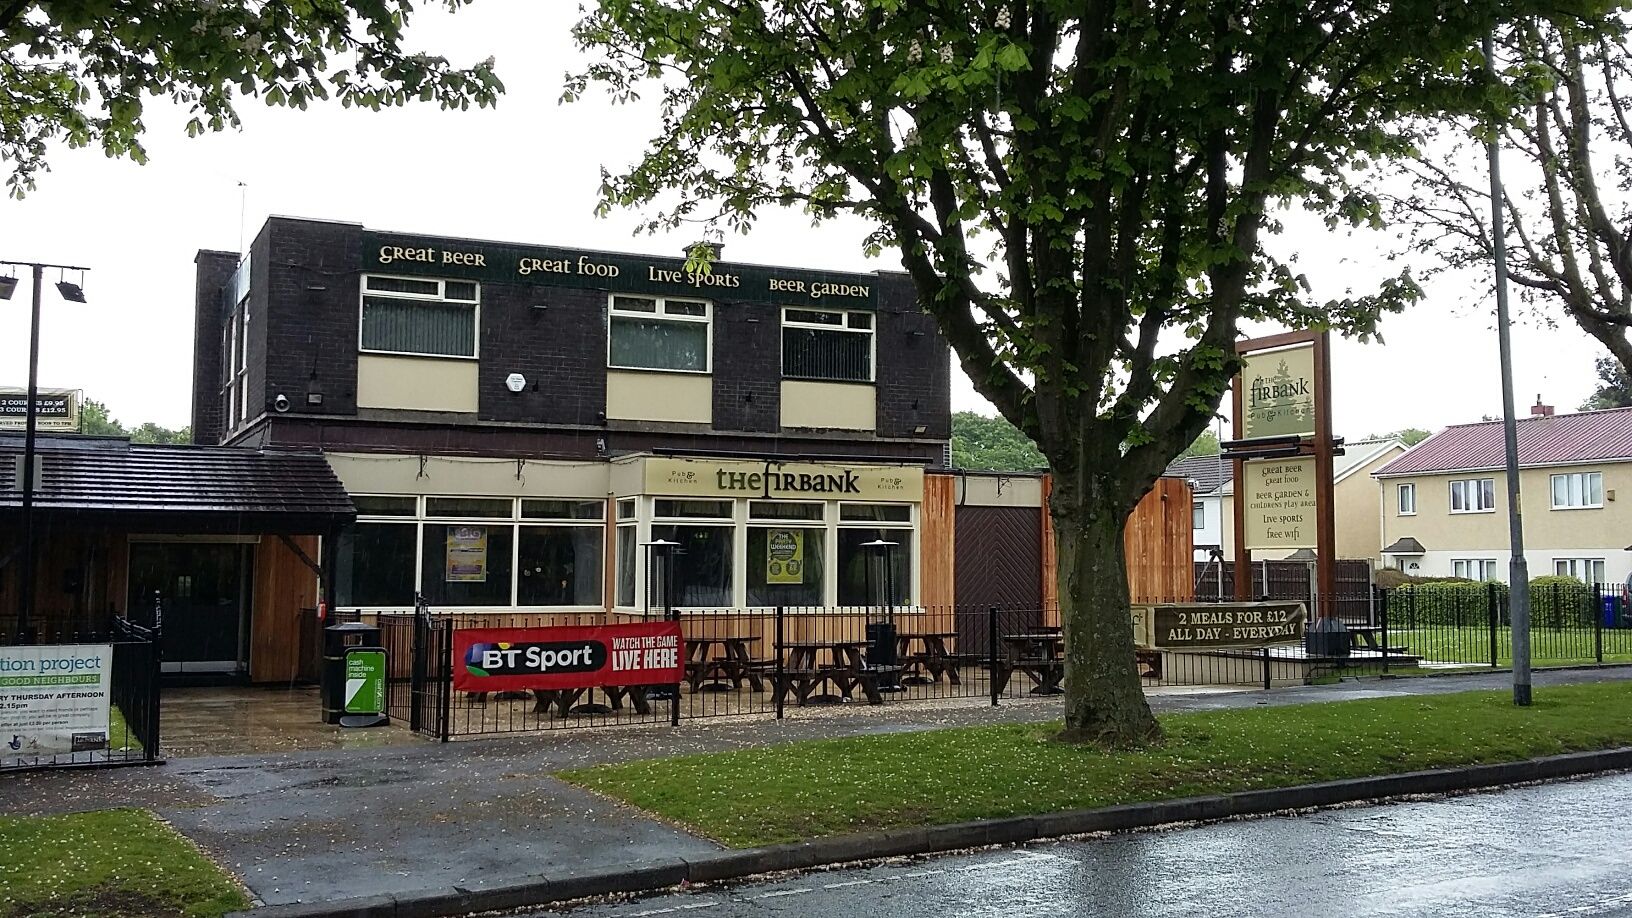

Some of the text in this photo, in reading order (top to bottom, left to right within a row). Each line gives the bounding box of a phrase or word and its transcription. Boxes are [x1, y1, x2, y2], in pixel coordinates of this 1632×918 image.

[1179, 610, 1287, 625] 2 MEALS FOR £12
[1168, 628, 1192, 641] ALL
[1196, 627, 1222, 640] DAY
[1233, 623, 1297, 640] EVERYDAY
[612, 635, 678, 650] WATCH THE GAME
[40, 655, 101, 673] project
[482, 645, 592, 671] BT Sport
[612, 648, 678, 671] LIVE HERE
[2, 675, 97, 686] GOOD NEIGHBOURS
[11, 693, 54, 701] THURSDAY
